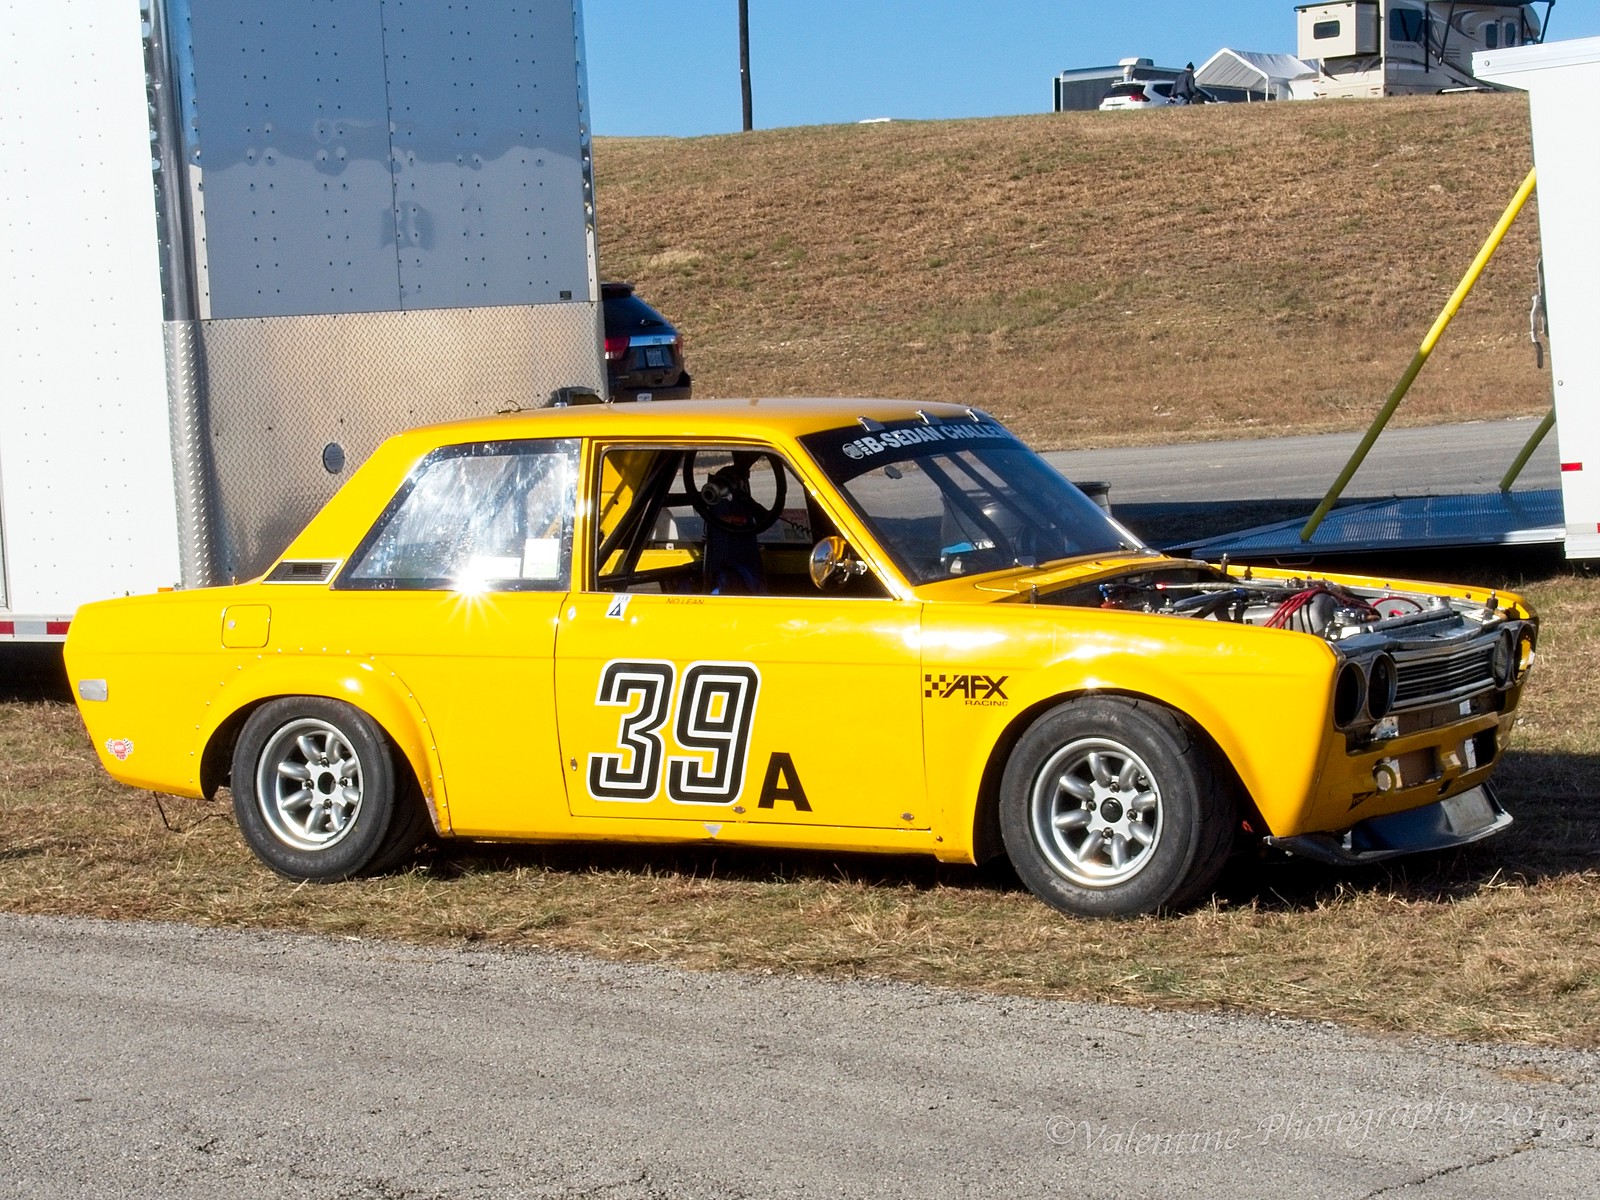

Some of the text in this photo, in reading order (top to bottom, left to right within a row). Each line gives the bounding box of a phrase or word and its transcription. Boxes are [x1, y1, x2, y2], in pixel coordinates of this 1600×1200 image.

[861, 425, 943, 453] B-SEDAN
[942, 675, 1009, 699] AFX
[586, 658, 762, 806] 39
[757, 751, 813, 813] A
